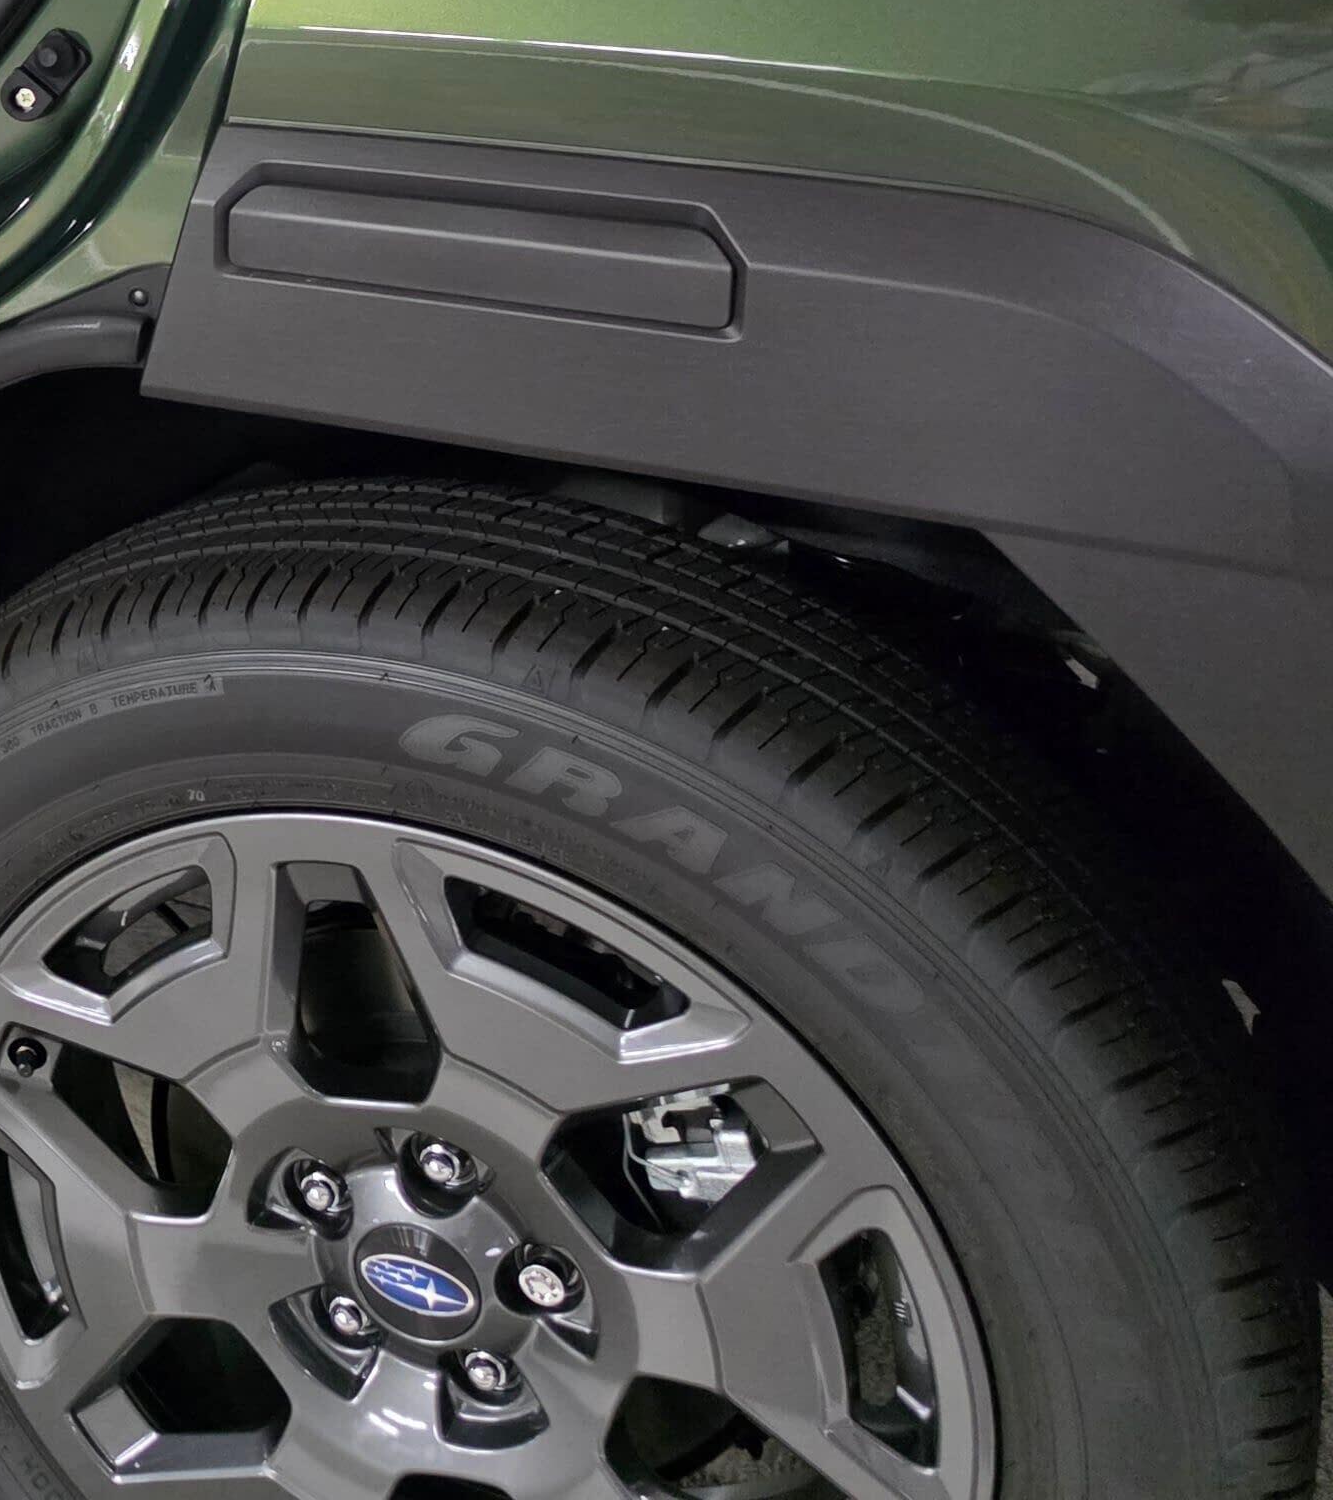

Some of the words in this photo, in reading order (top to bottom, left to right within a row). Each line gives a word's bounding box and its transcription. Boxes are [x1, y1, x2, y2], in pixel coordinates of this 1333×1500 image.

[29, 707, 82, 736] TRACTION
[88, 703, 99, 715] B
[110, 682, 198, 708] TEMPERATURE
